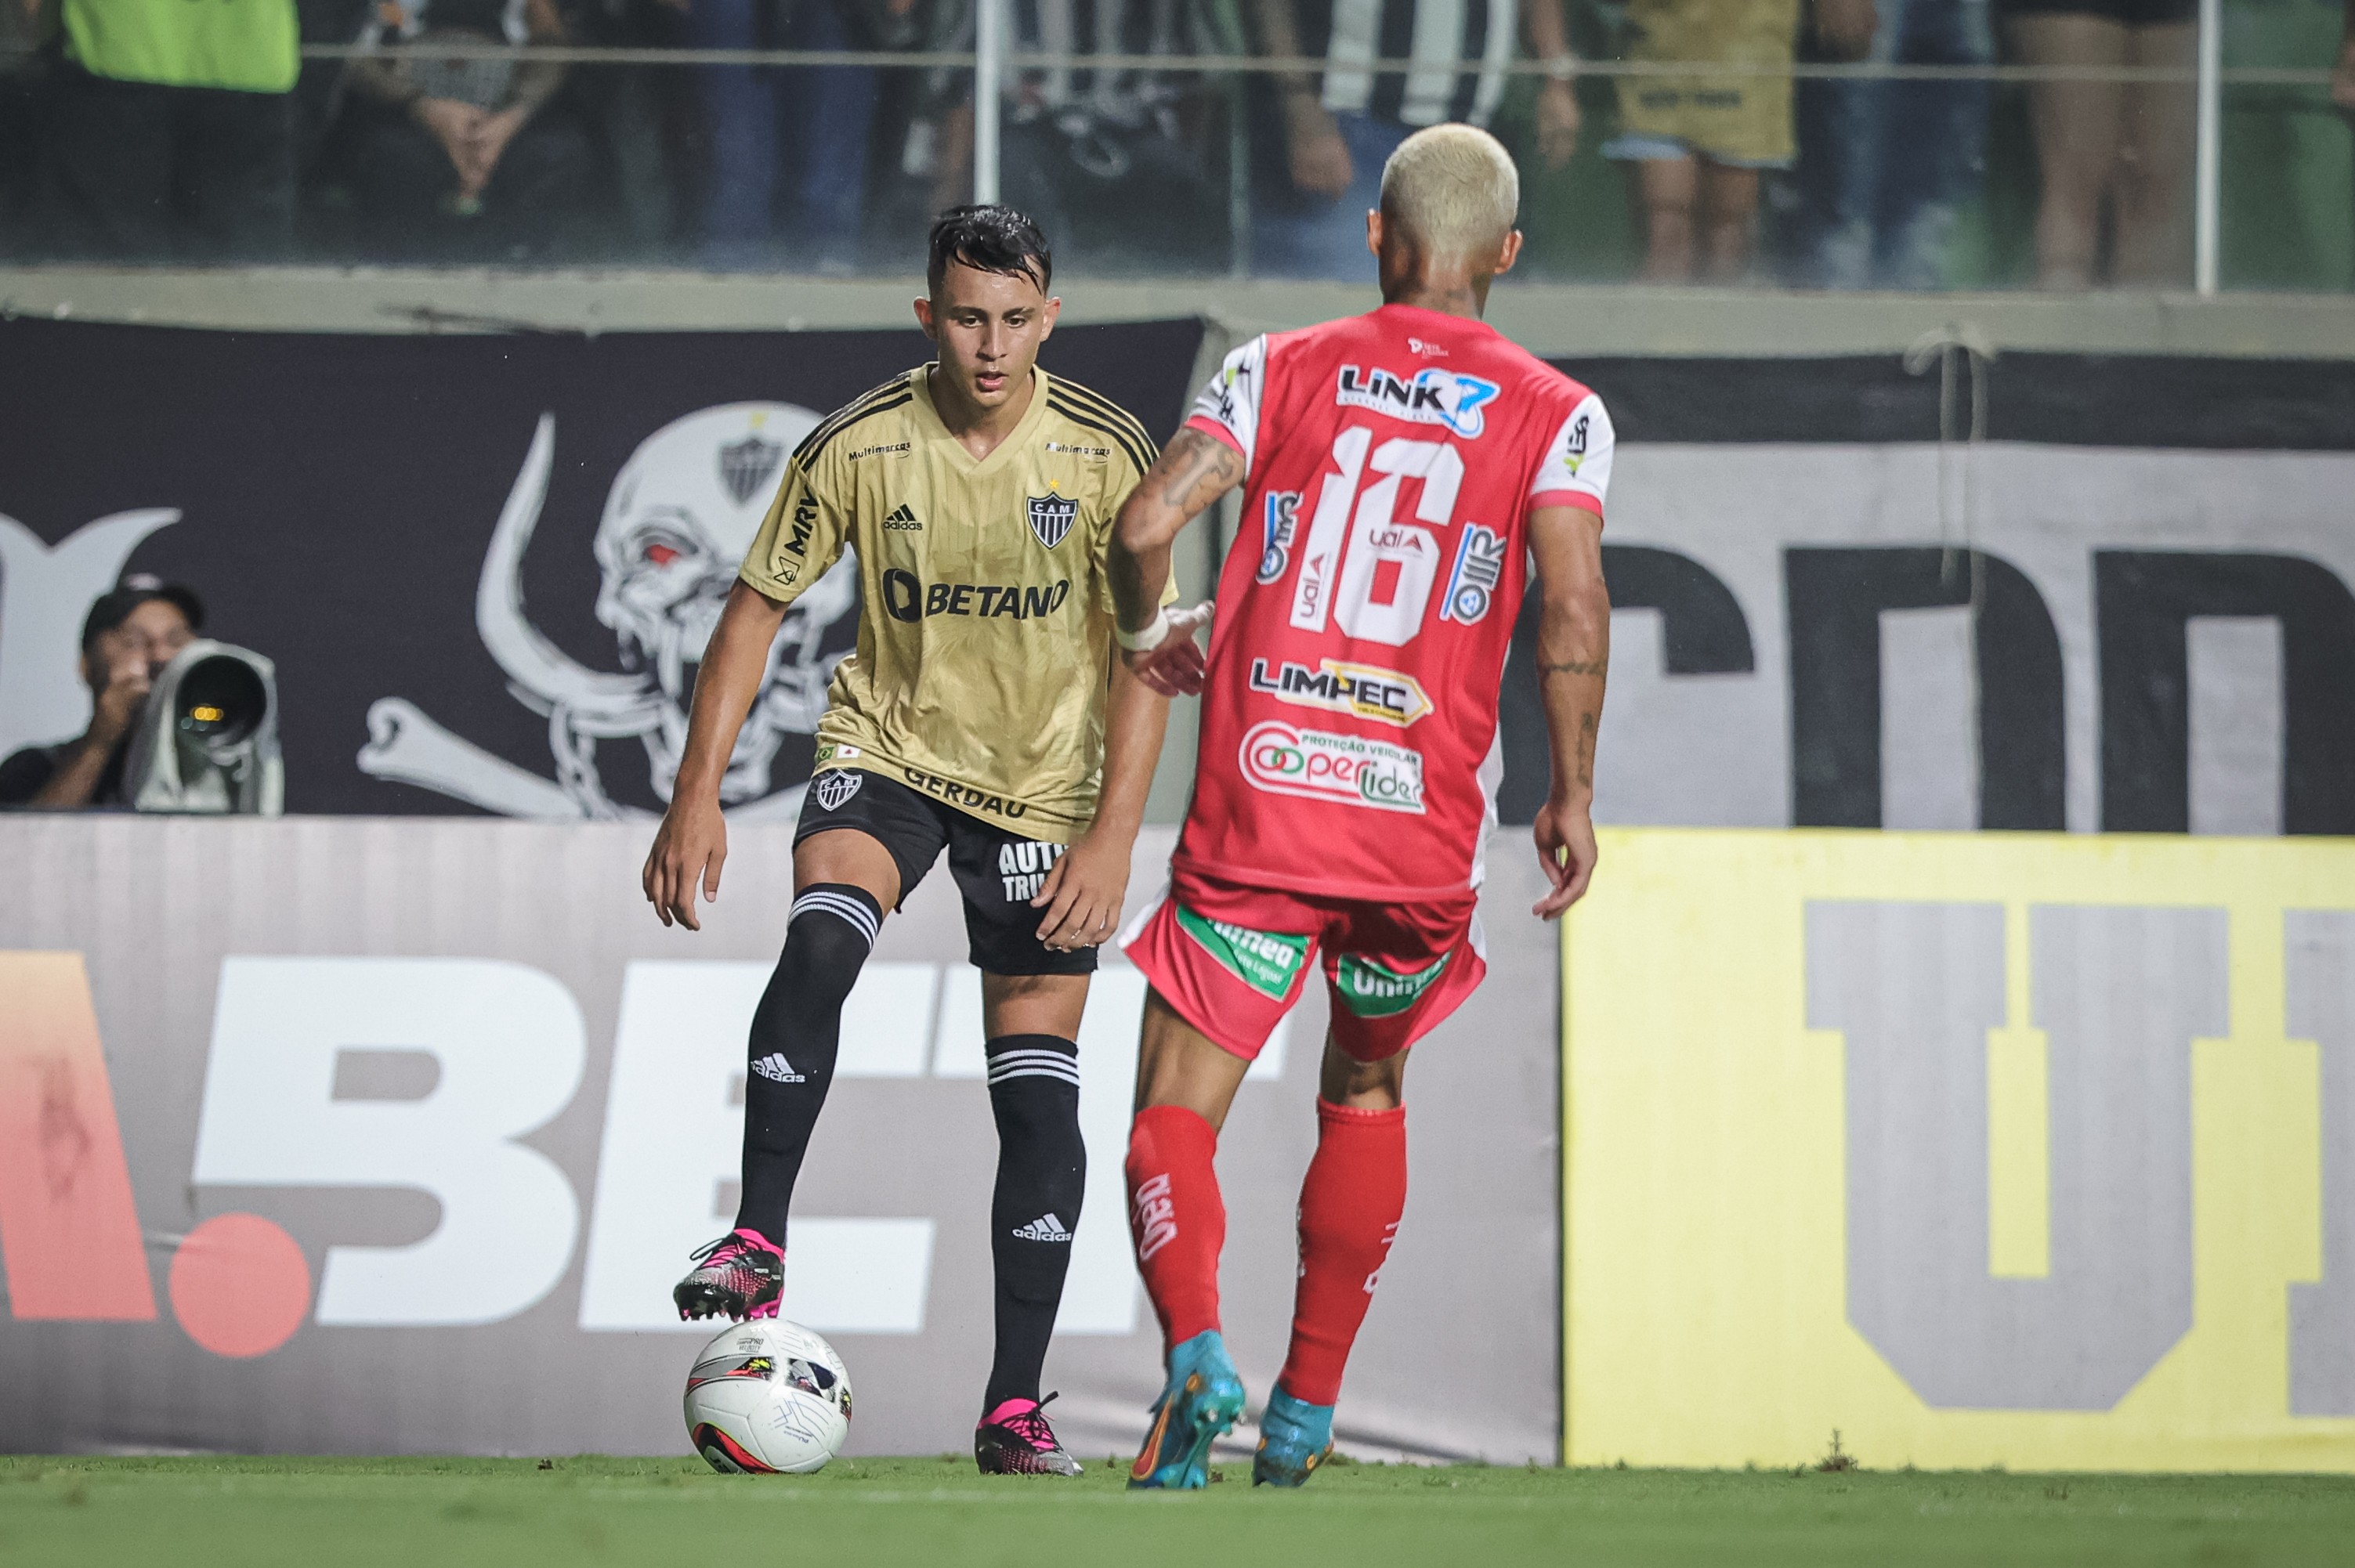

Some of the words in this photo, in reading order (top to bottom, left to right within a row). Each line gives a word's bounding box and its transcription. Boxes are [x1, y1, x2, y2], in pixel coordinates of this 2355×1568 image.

[848, 442, 910, 461] Multimarcas
[784, 485, 819, 557] MRV
[1035, 504, 1070, 514] CAM
[883, 520, 923, 531] adidas
[1290, 425, 1464, 647] 16
[925, 580, 1069, 620] BETANO
[1253, 663, 1407, 713] LIMPEC
[824, 779, 853, 789] CAM
[904, 766, 1028, 818] GERDAU
[1003, 873, 1044, 901] TRU
[1012, 1228, 1072, 1241] adidas
